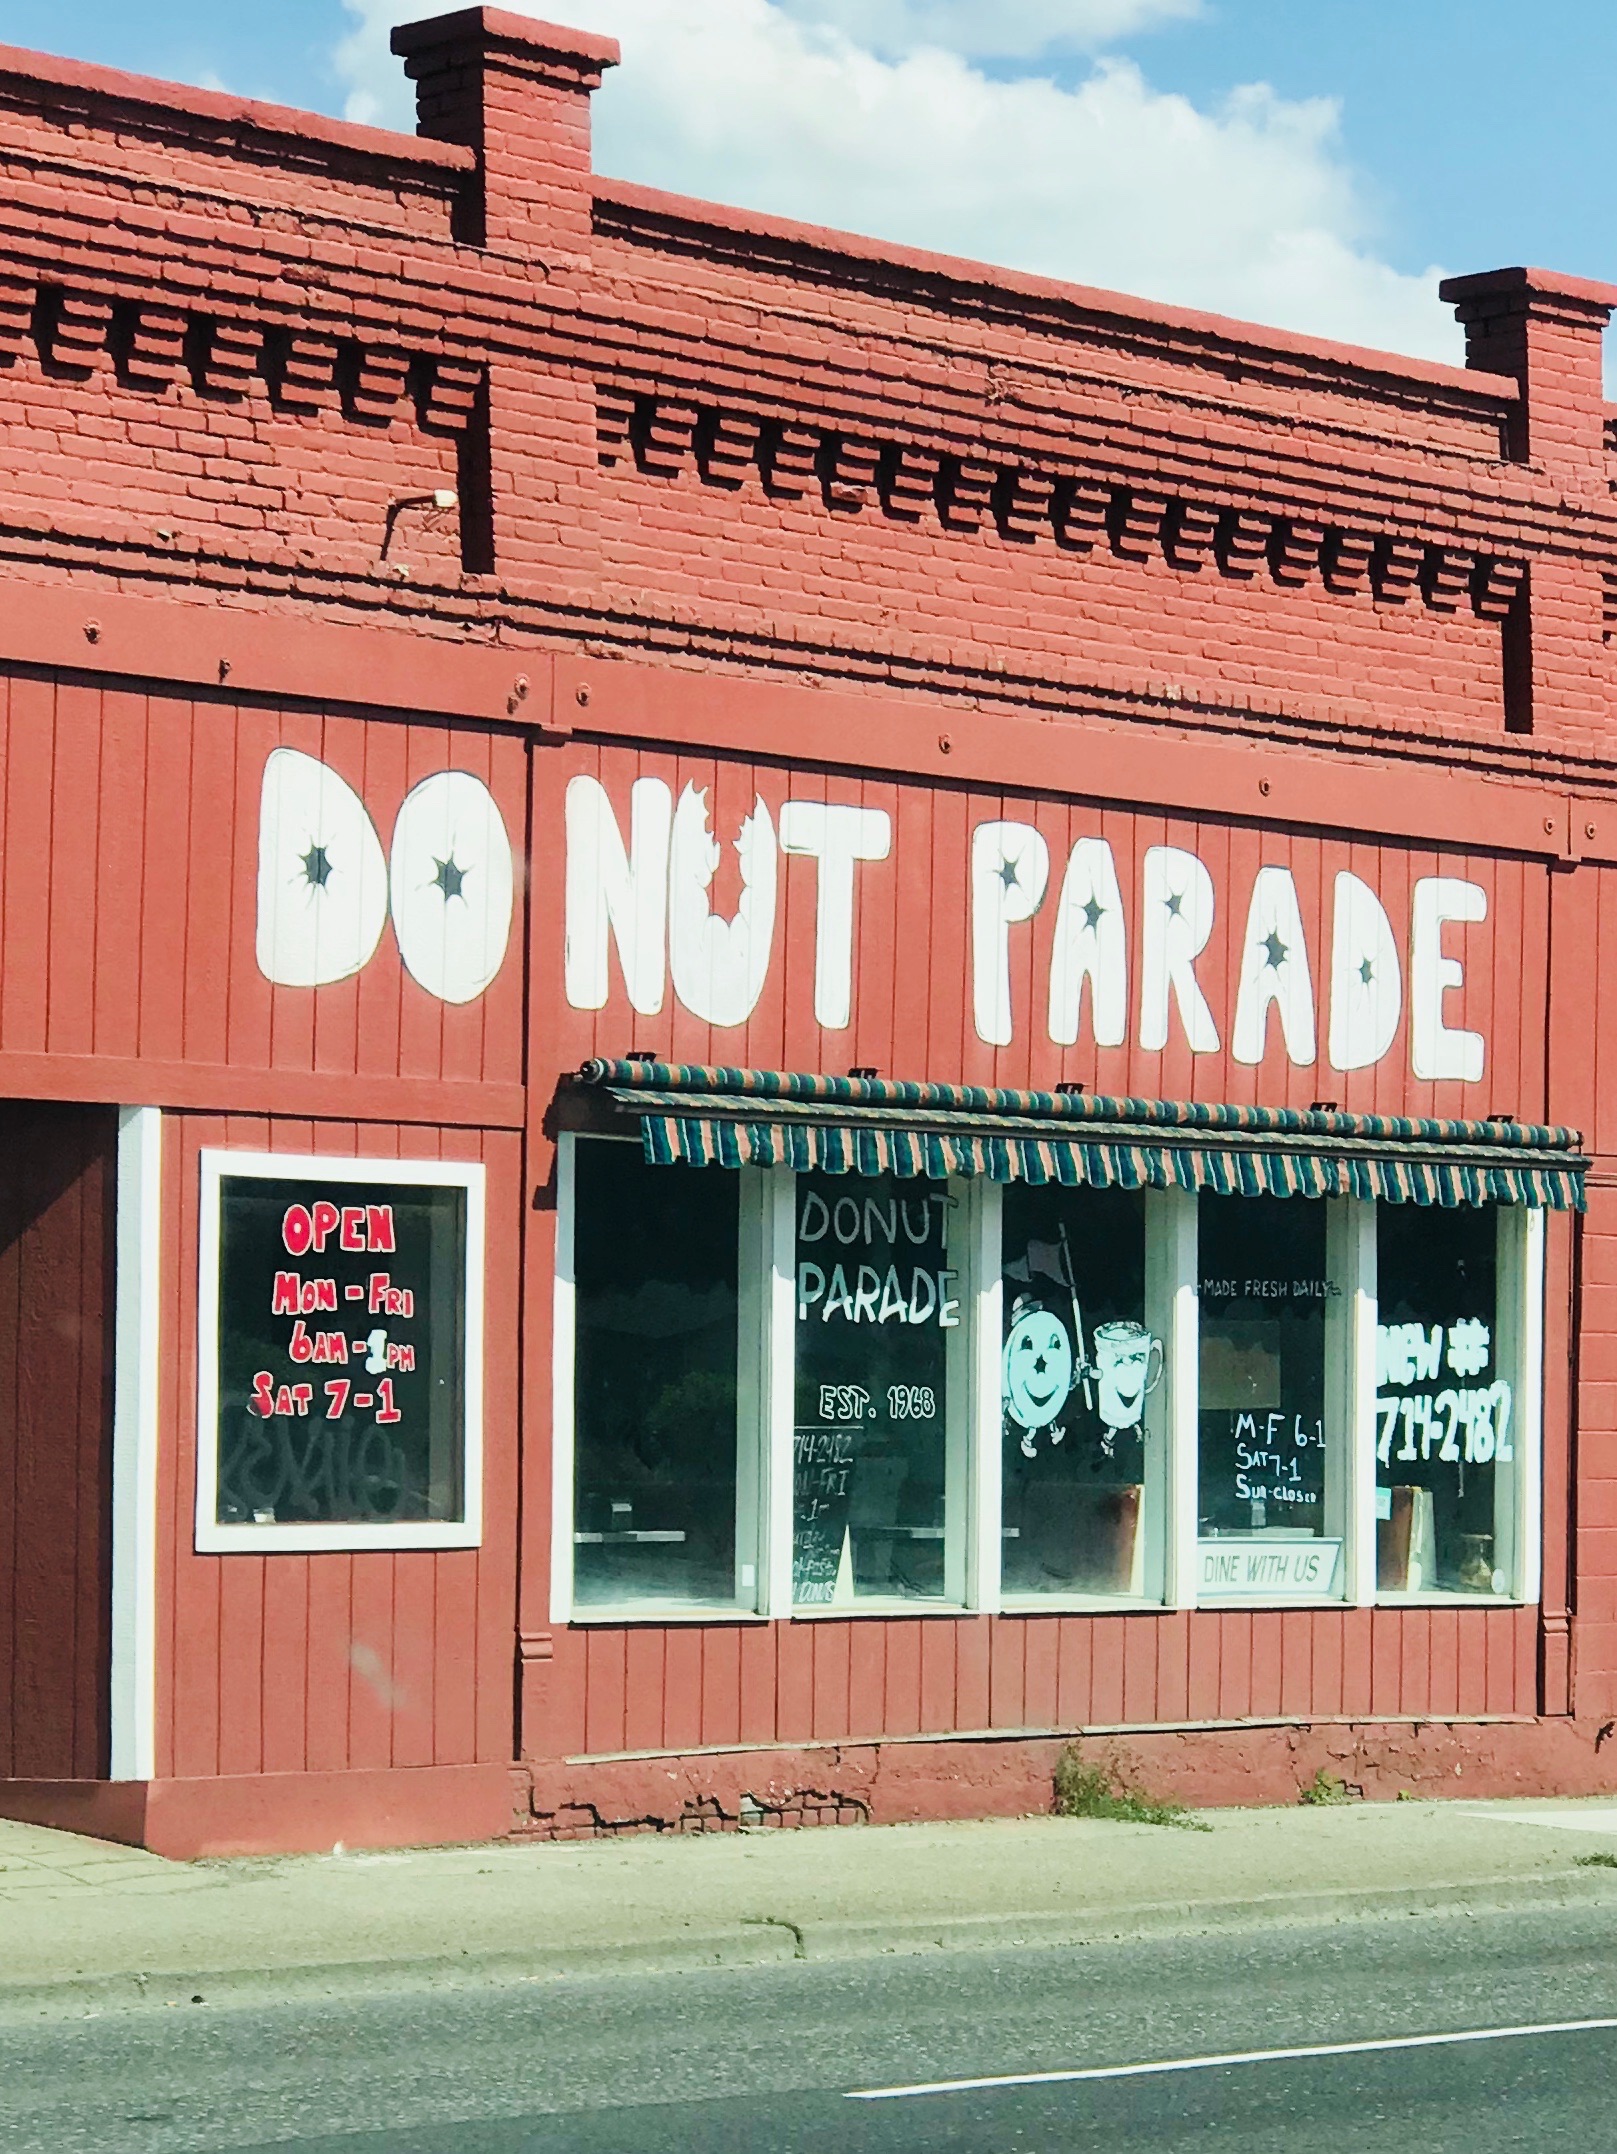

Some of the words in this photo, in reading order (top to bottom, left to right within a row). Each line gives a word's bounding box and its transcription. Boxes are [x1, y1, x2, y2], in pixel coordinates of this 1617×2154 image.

[256, 746, 891, 1029] DONUT
[972, 820, 1487, 1083] PARADE
[282, 1201, 396, 1256] OPEN
[799, 1190, 960, 1249] DONUT
[799, 1262, 960, 1327] PARADE
[1203, 1279, 1237, 1297] MADE
[1244, 1279, 1288, 1297] FRESH
[1292, 1279, 1333, 1298] DAILY
[1447, 1317, 1490, 1377] #
[246, 1371, 313, 1418] SAT
[819, 1385, 877, 1419] EST.
[887, 1385, 936, 1419] 1968
[1235, 1413, 1286, 1445] M-F
[1294, 1414, 1327, 1448] 6-1
[1377, 1380, 1514, 1464] 714-2482
[1235, 1443, 1269, 1469] SAT
[1269, 1455, 1302, 1482] 7-1
[1204, 1555, 1240, 1582] DINE
[1247, 1555, 1289, 1582] WITH
[1294, 1554, 1320, 1582] US
